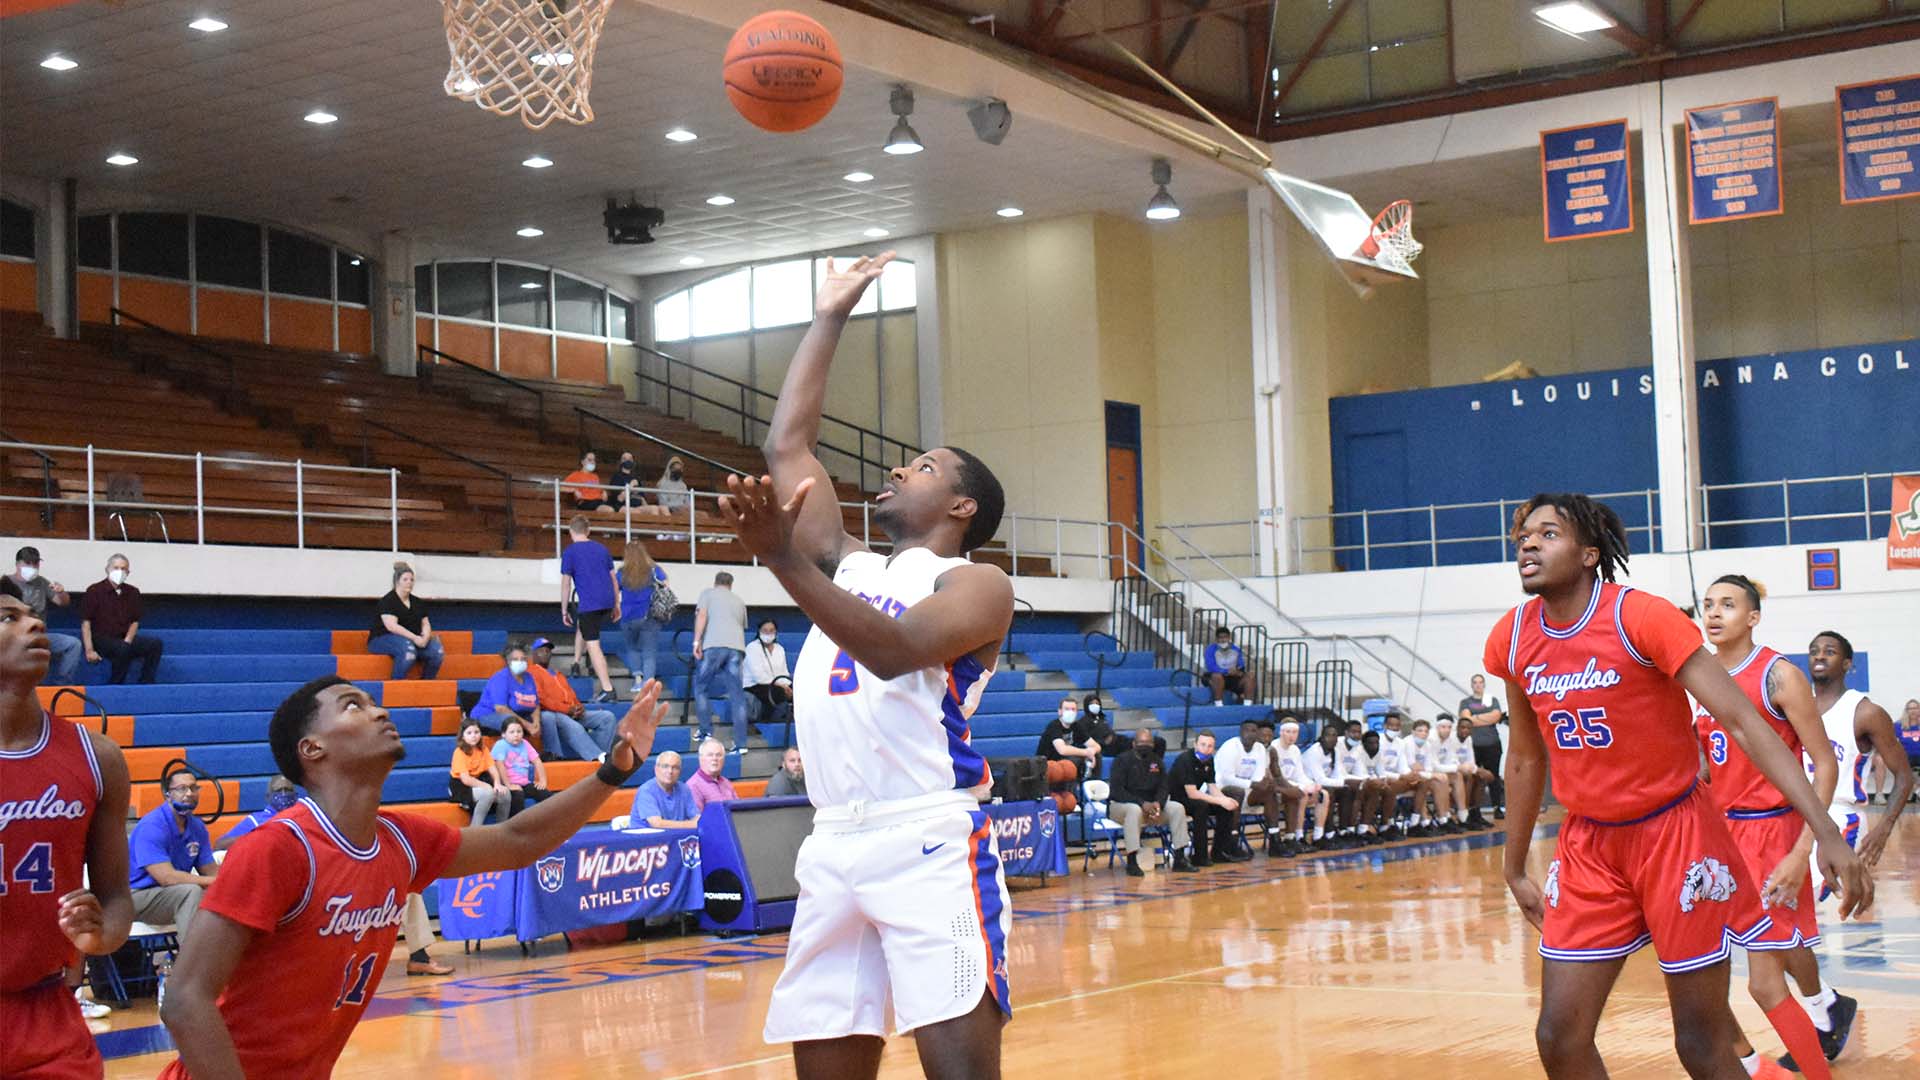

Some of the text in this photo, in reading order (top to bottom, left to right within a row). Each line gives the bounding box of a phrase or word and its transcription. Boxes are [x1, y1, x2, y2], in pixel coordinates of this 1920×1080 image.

[1511, 361, 1789, 406] LOUISANA
[1524, 656, 1621, 701] Tougaloo
[1548, 706, 1614, 749] 25
[1709, 730, 1728, 766] 3
[995, 815, 1033, 847] DCATS
[576, 844, 670, 890] WILDCATS
[1000, 846, 1034, 862] ETICS
[579, 881, 671, 911] ATHLETICS
